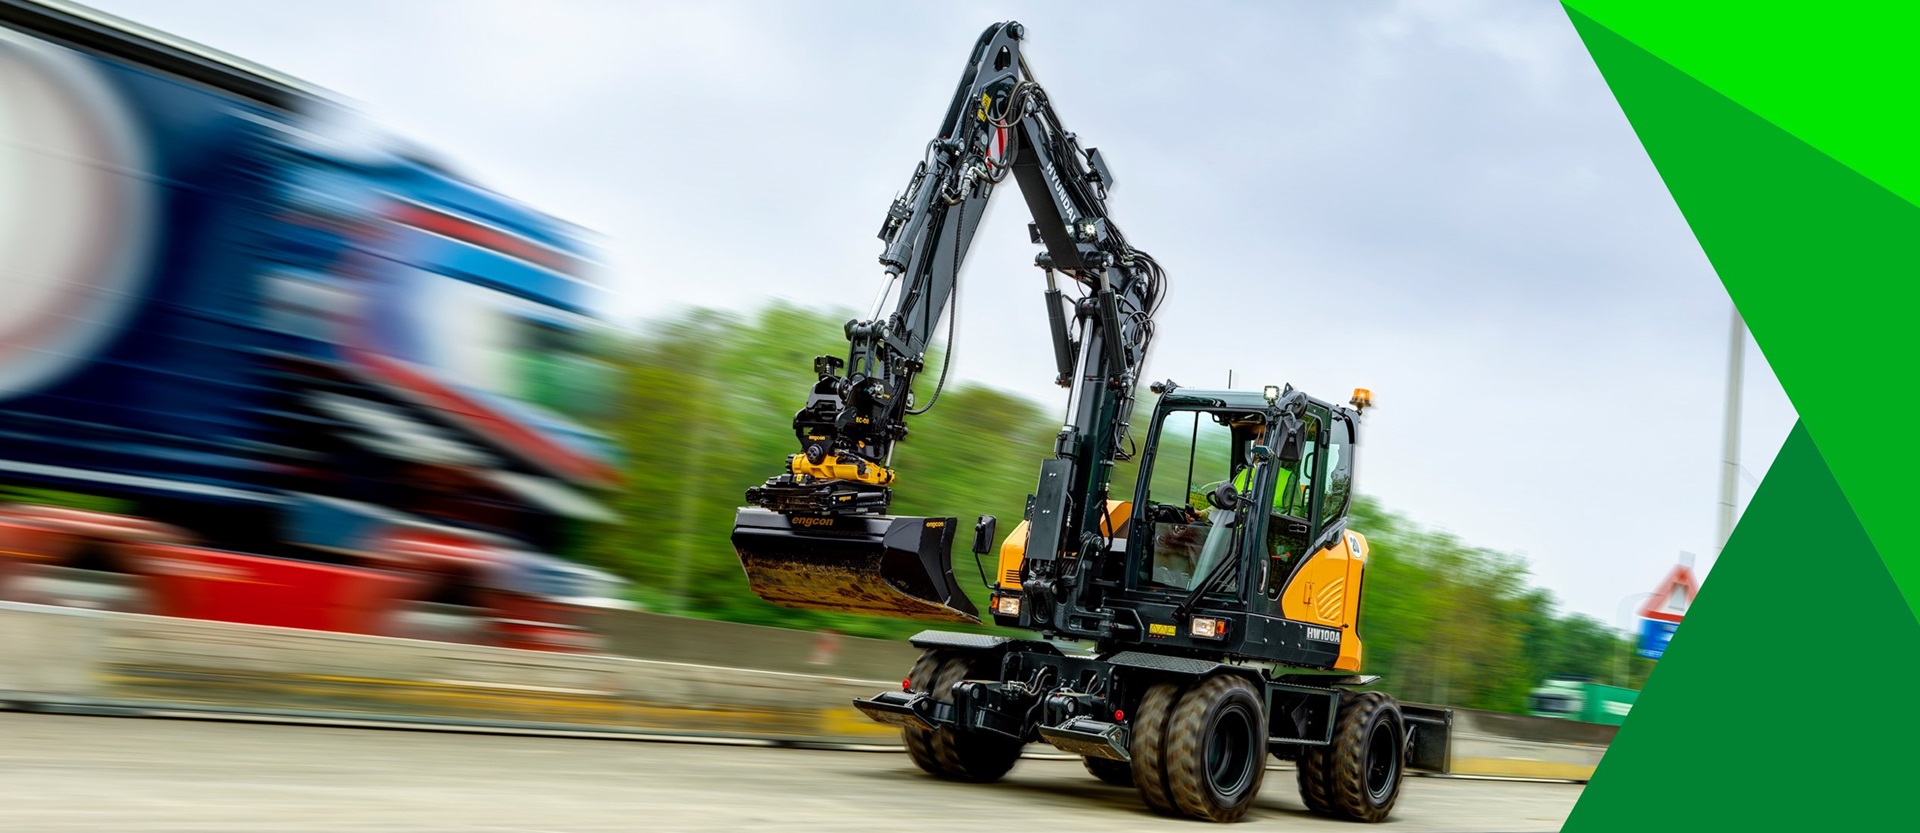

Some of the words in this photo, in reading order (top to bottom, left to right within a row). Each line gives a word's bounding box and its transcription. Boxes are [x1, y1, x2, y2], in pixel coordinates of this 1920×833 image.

[1046, 161, 1076, 224] HYUNDAI
[791, 516, 834, 527] engcon
[1306, 627, 1341, 643] HW100A
